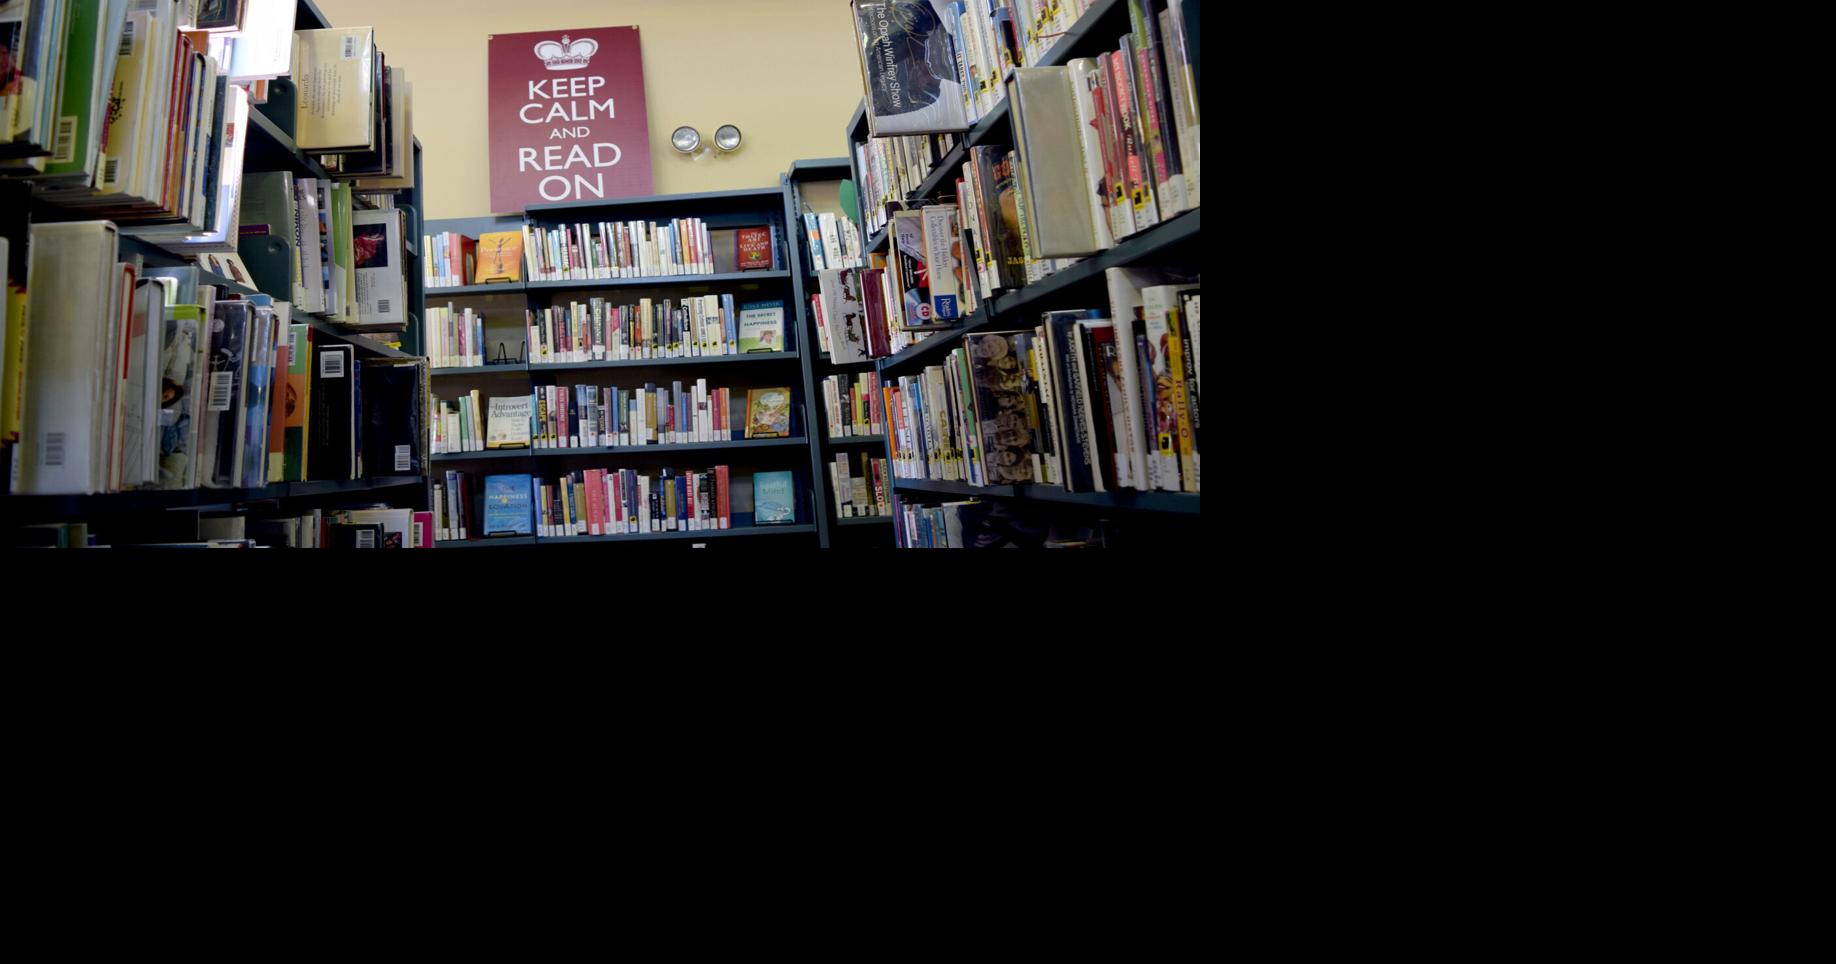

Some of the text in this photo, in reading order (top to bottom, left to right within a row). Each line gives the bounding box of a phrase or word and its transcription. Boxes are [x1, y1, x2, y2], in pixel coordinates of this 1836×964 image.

[875, 47, 884, 72] American
[876, 1, 902, 108] The Oprah Winfrey Show
[528, 76, 606, 100] KEEP
[519, 98, 615, 124] CALM
[549, 126, 591, 140] AND
[518, 142, 622, 172] READ
[538, 173, 605, 201] ON
[1007, 256, 1024, 265] JAS
[1183, 338, 1200, 429] improv for actors
[491, 409, 531, 418] Advantage
[495, 402, 528, 411] Introvert
